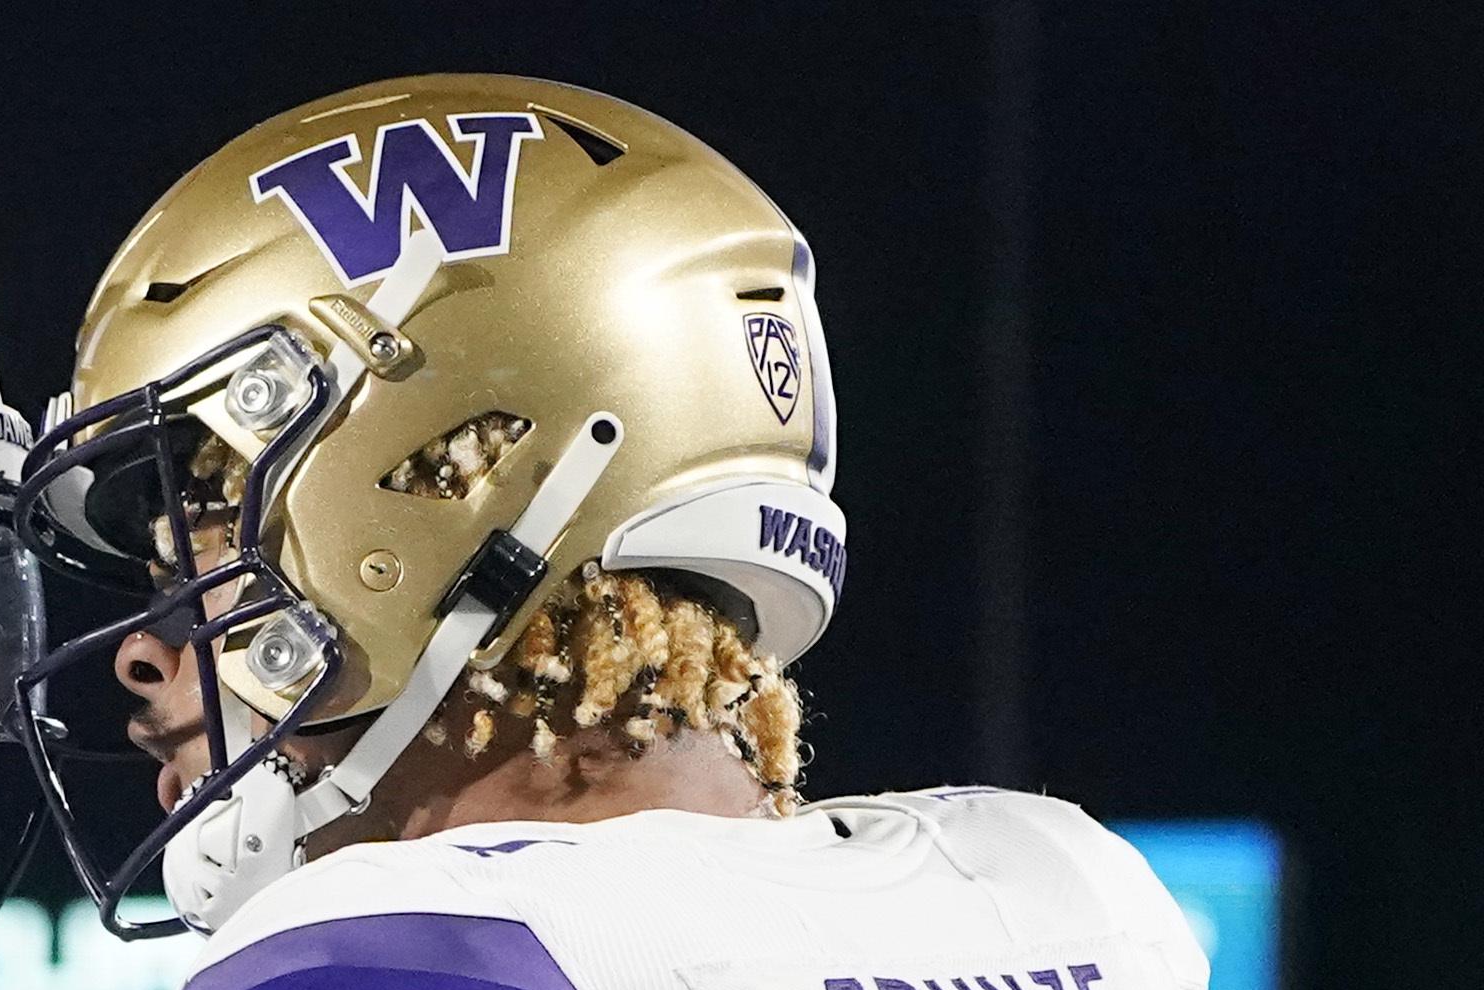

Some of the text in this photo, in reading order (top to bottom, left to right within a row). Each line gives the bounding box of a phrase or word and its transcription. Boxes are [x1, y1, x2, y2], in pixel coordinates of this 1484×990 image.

[248, 112, 545, 290] W
[747, 317, 799, 380] PAC
[766, 359, 794, 400] 12
